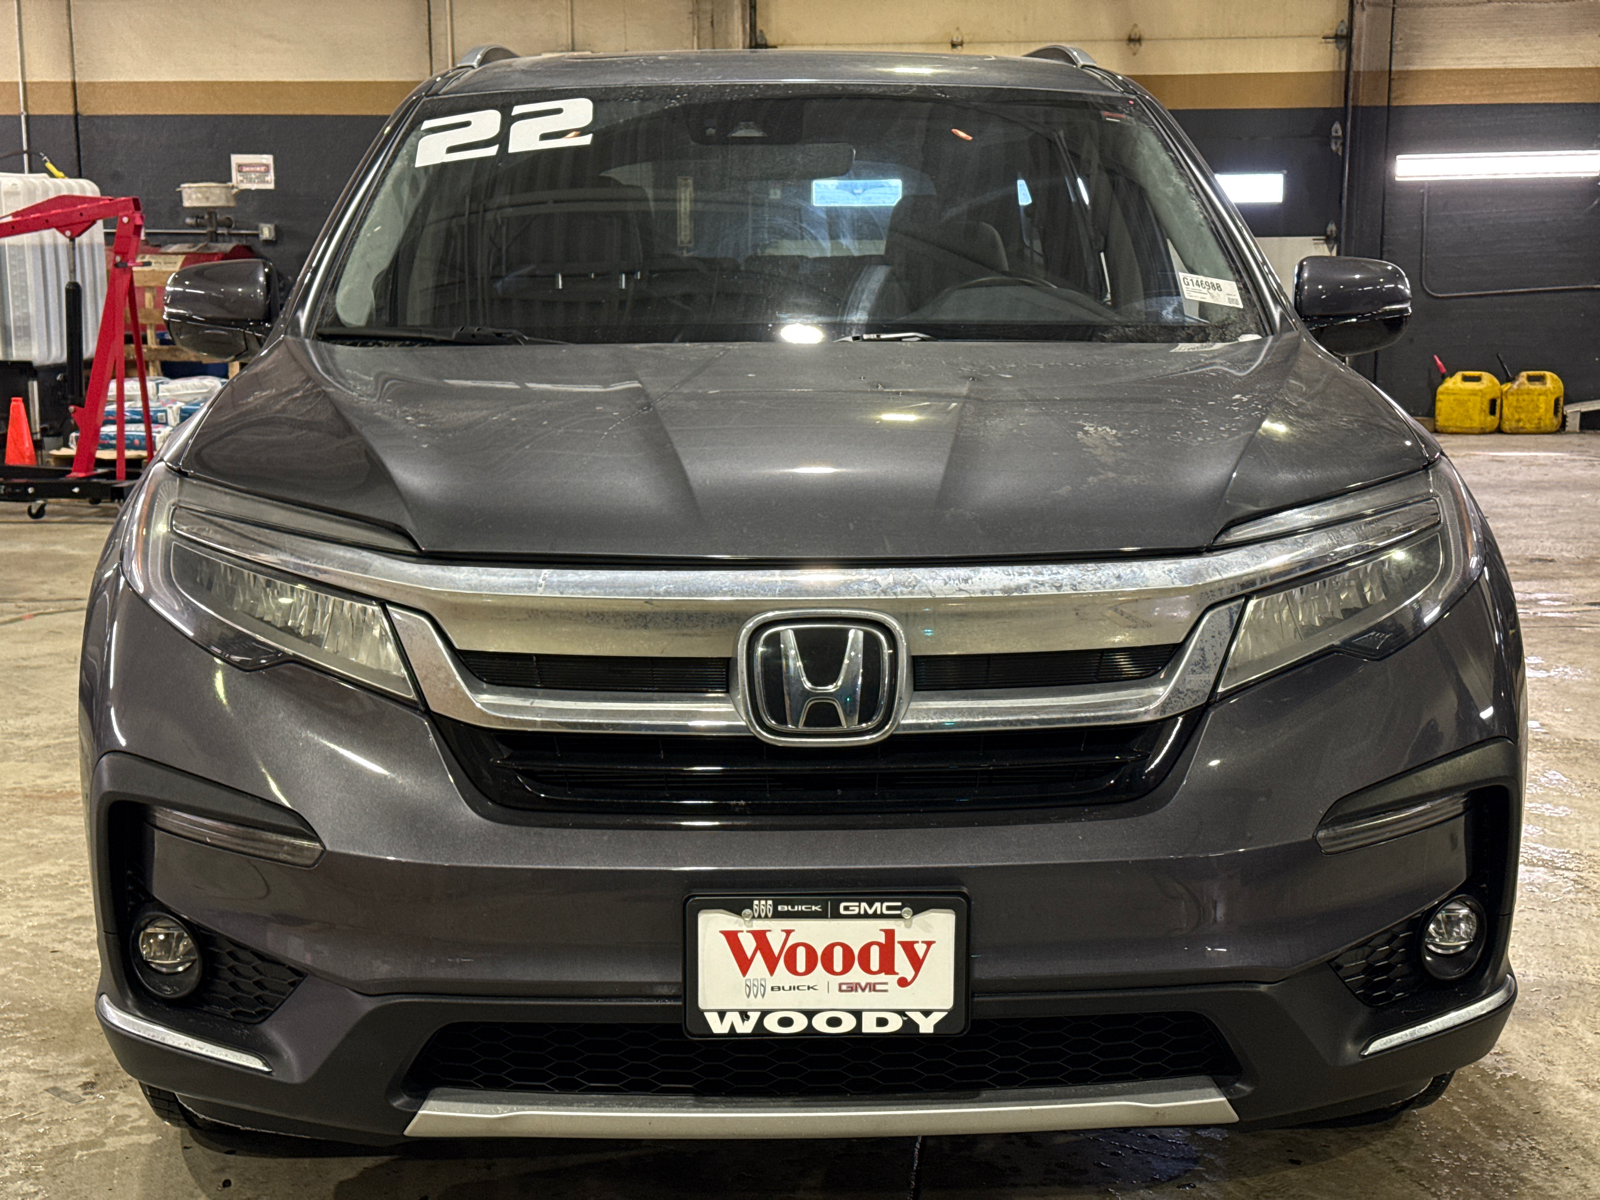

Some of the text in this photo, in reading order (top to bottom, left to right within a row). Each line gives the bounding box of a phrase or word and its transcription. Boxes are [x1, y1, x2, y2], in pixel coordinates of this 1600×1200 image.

[415, 98, 593, 168] 22
[777, 901, 902, 915] BUICK GMC
[719, 929, 936, 988] Woody
[770, 982, 889, 993] BUICK GMC
[703, 1011, 948, 1034] WOODY
